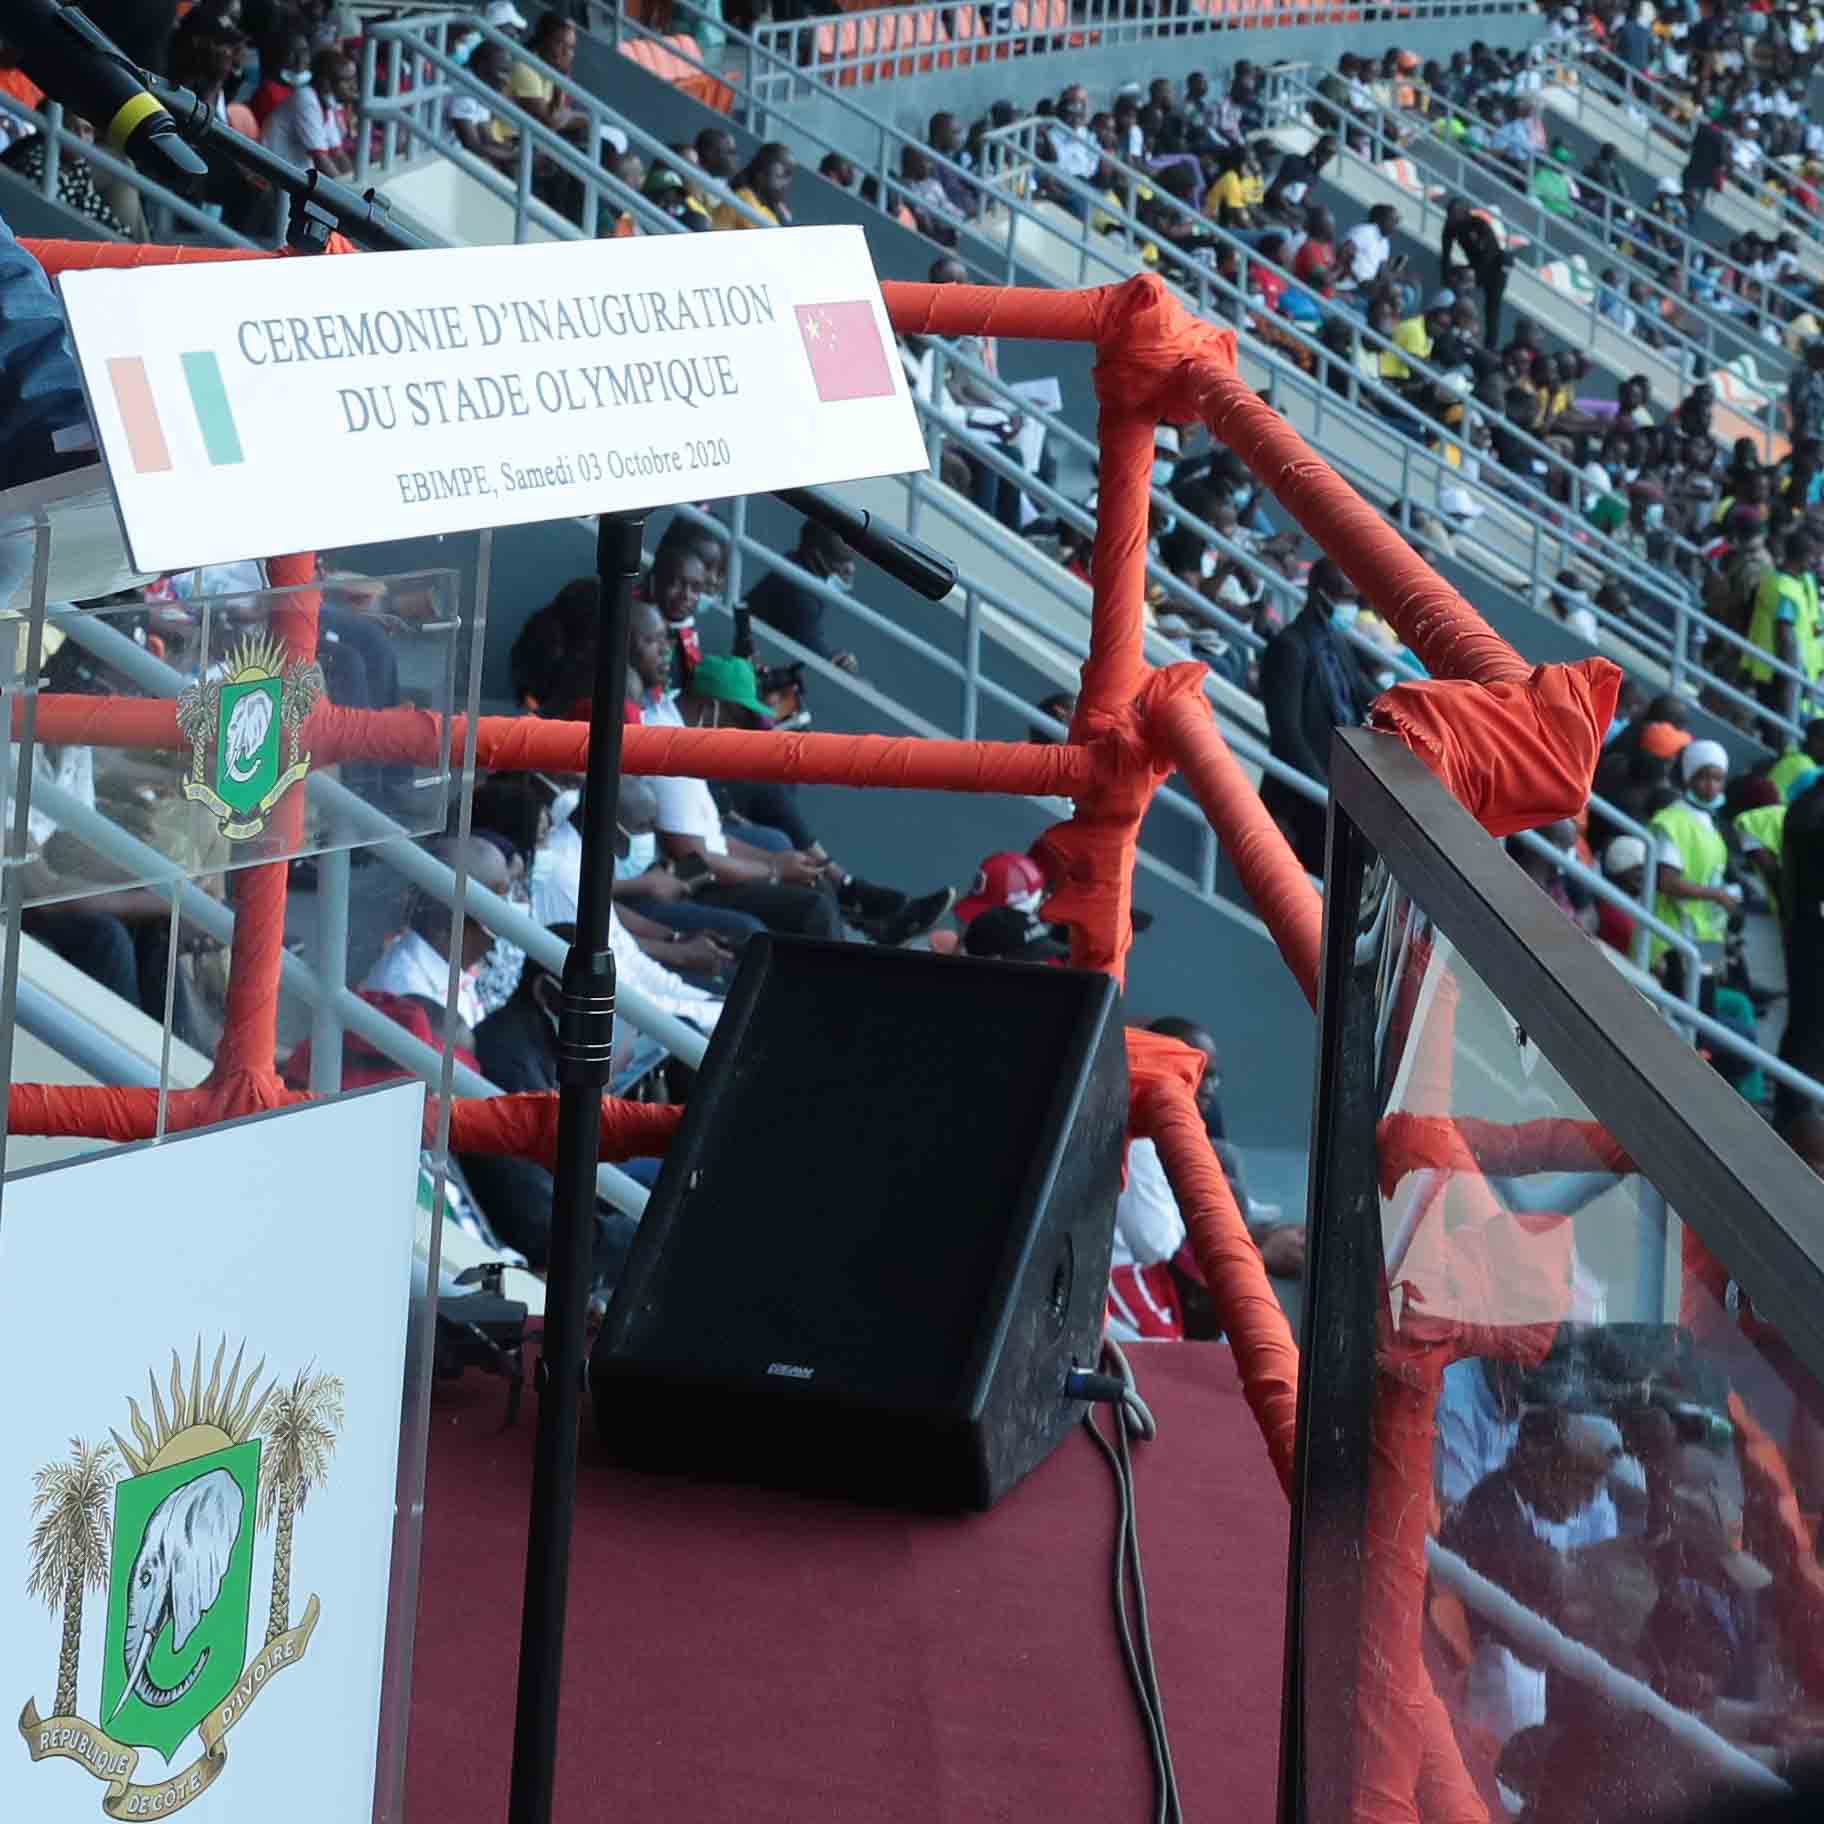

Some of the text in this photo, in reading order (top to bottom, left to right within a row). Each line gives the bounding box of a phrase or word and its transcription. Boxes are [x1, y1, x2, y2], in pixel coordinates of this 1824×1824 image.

[237, 283, 776, 366] CEREMONIE D'INAUGURATION
[335, 354, 739, 433] DU STADE OLYMPIQUE
[396, 437, 731, 504] EBIMPE, Samedi 03 Octobre 2020
[39, 1723, 130, 1776] RÉPUBLIQUE
[127, 1790, 150, 1814] DE
[221, 1639, 295, 1725] D'IVOIRE
